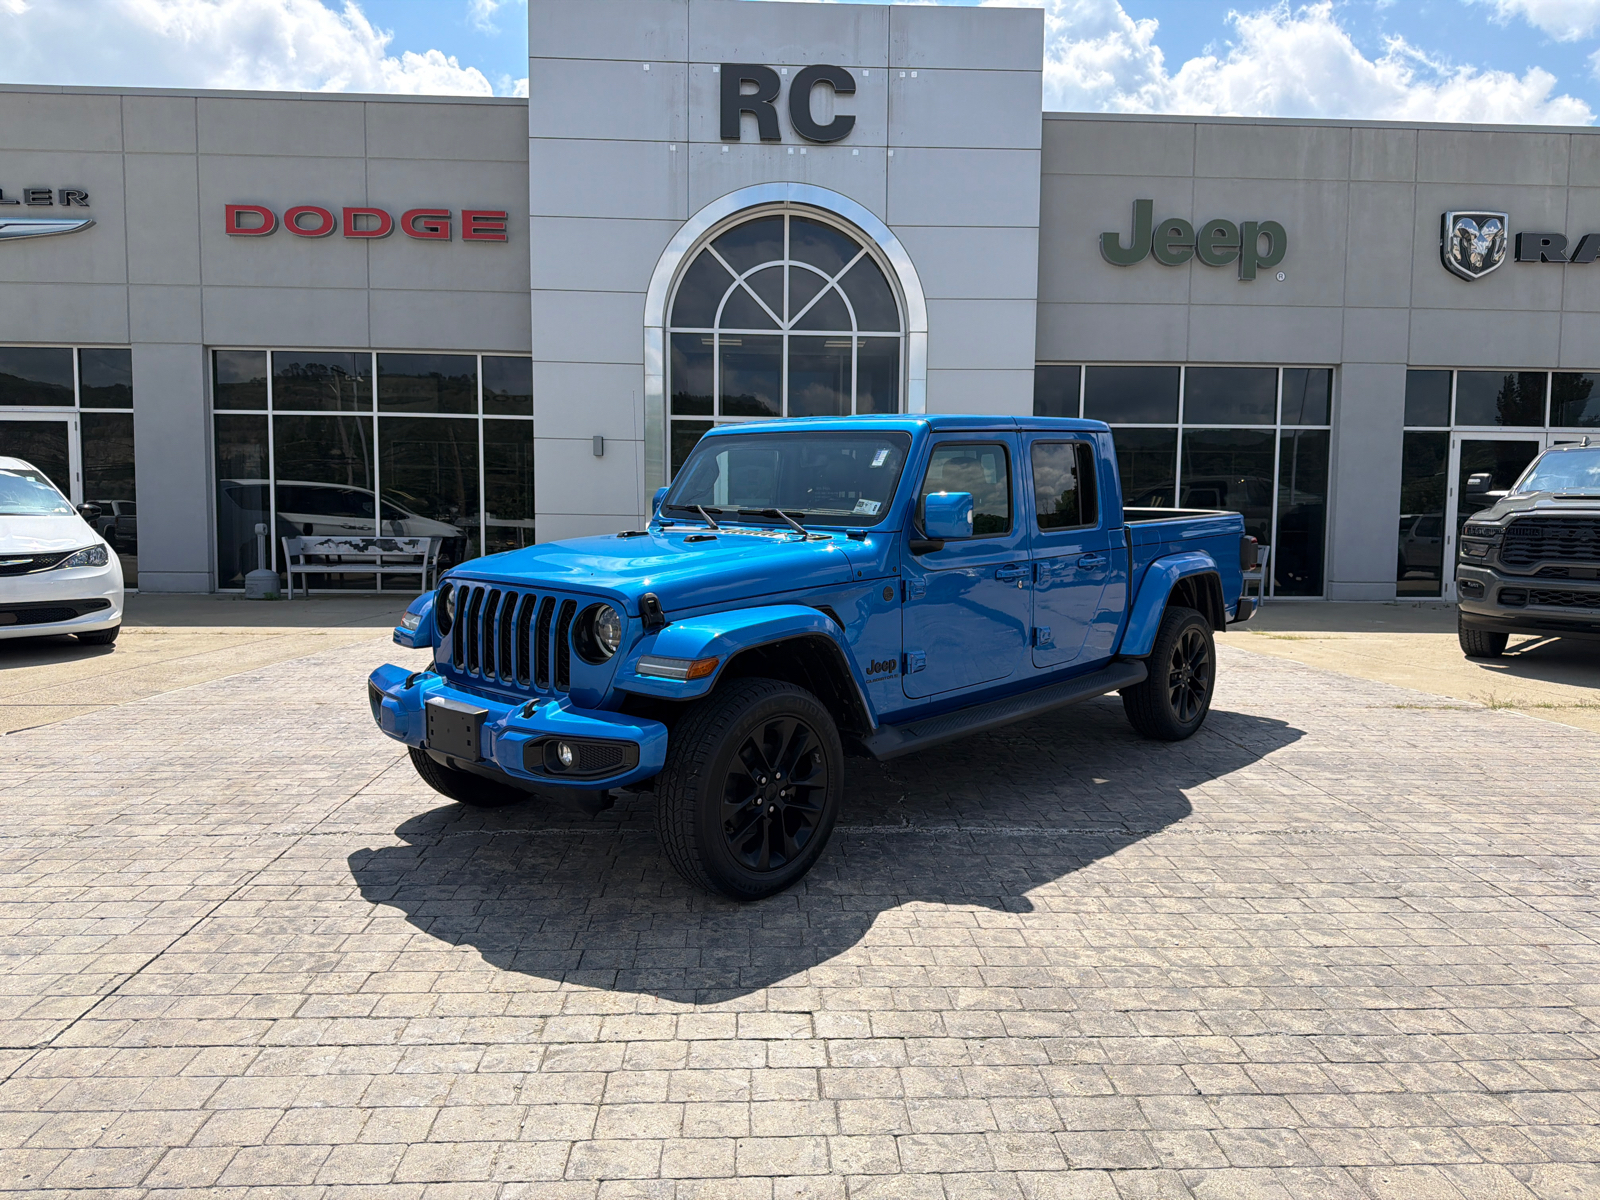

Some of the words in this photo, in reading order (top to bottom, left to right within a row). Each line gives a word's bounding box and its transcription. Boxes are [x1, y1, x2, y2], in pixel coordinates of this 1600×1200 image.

[720, 63, 856, 143] RC
[225, 204, 507, 242] DODGE
[1100, 199, 1287, 281] Jeep
[866, 659, 897, 675] Jeep
